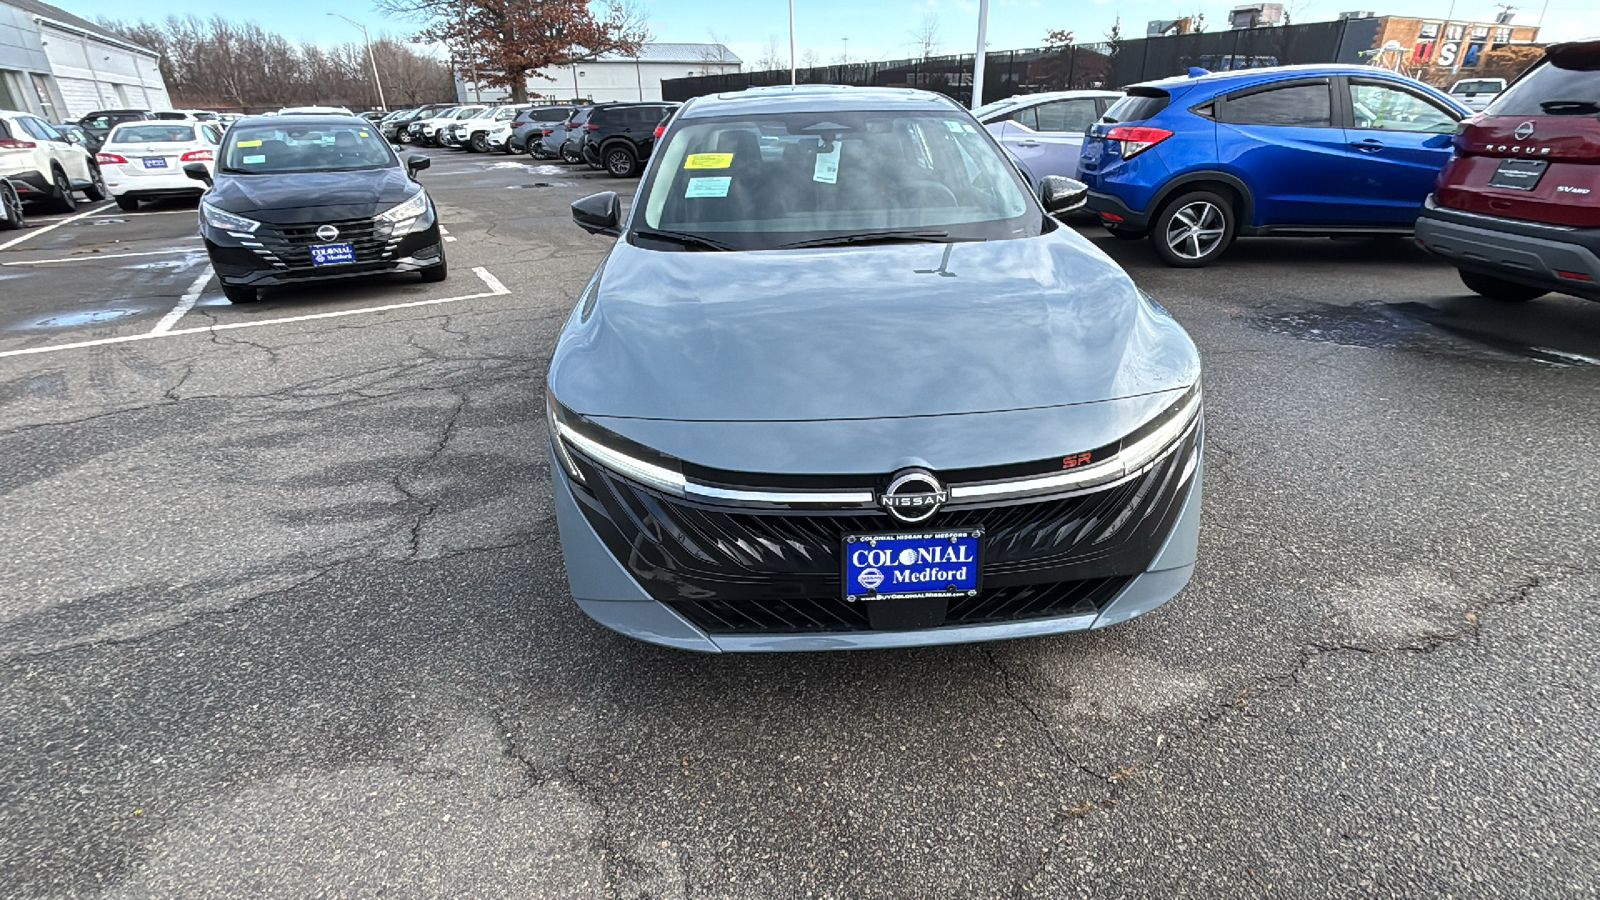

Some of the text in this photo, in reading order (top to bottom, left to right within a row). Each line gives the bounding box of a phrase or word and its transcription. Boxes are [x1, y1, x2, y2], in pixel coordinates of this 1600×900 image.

[1411, 42, 1479, 67] USA
[1485, 144, 1551, 154] ROGUE
[1062, 452, 1092, 469] SR
[882, 493, 946, 506] NISSAN
[852, 545, 974, 567] COLONIAL
[892, 566, 968, 584] Medford
